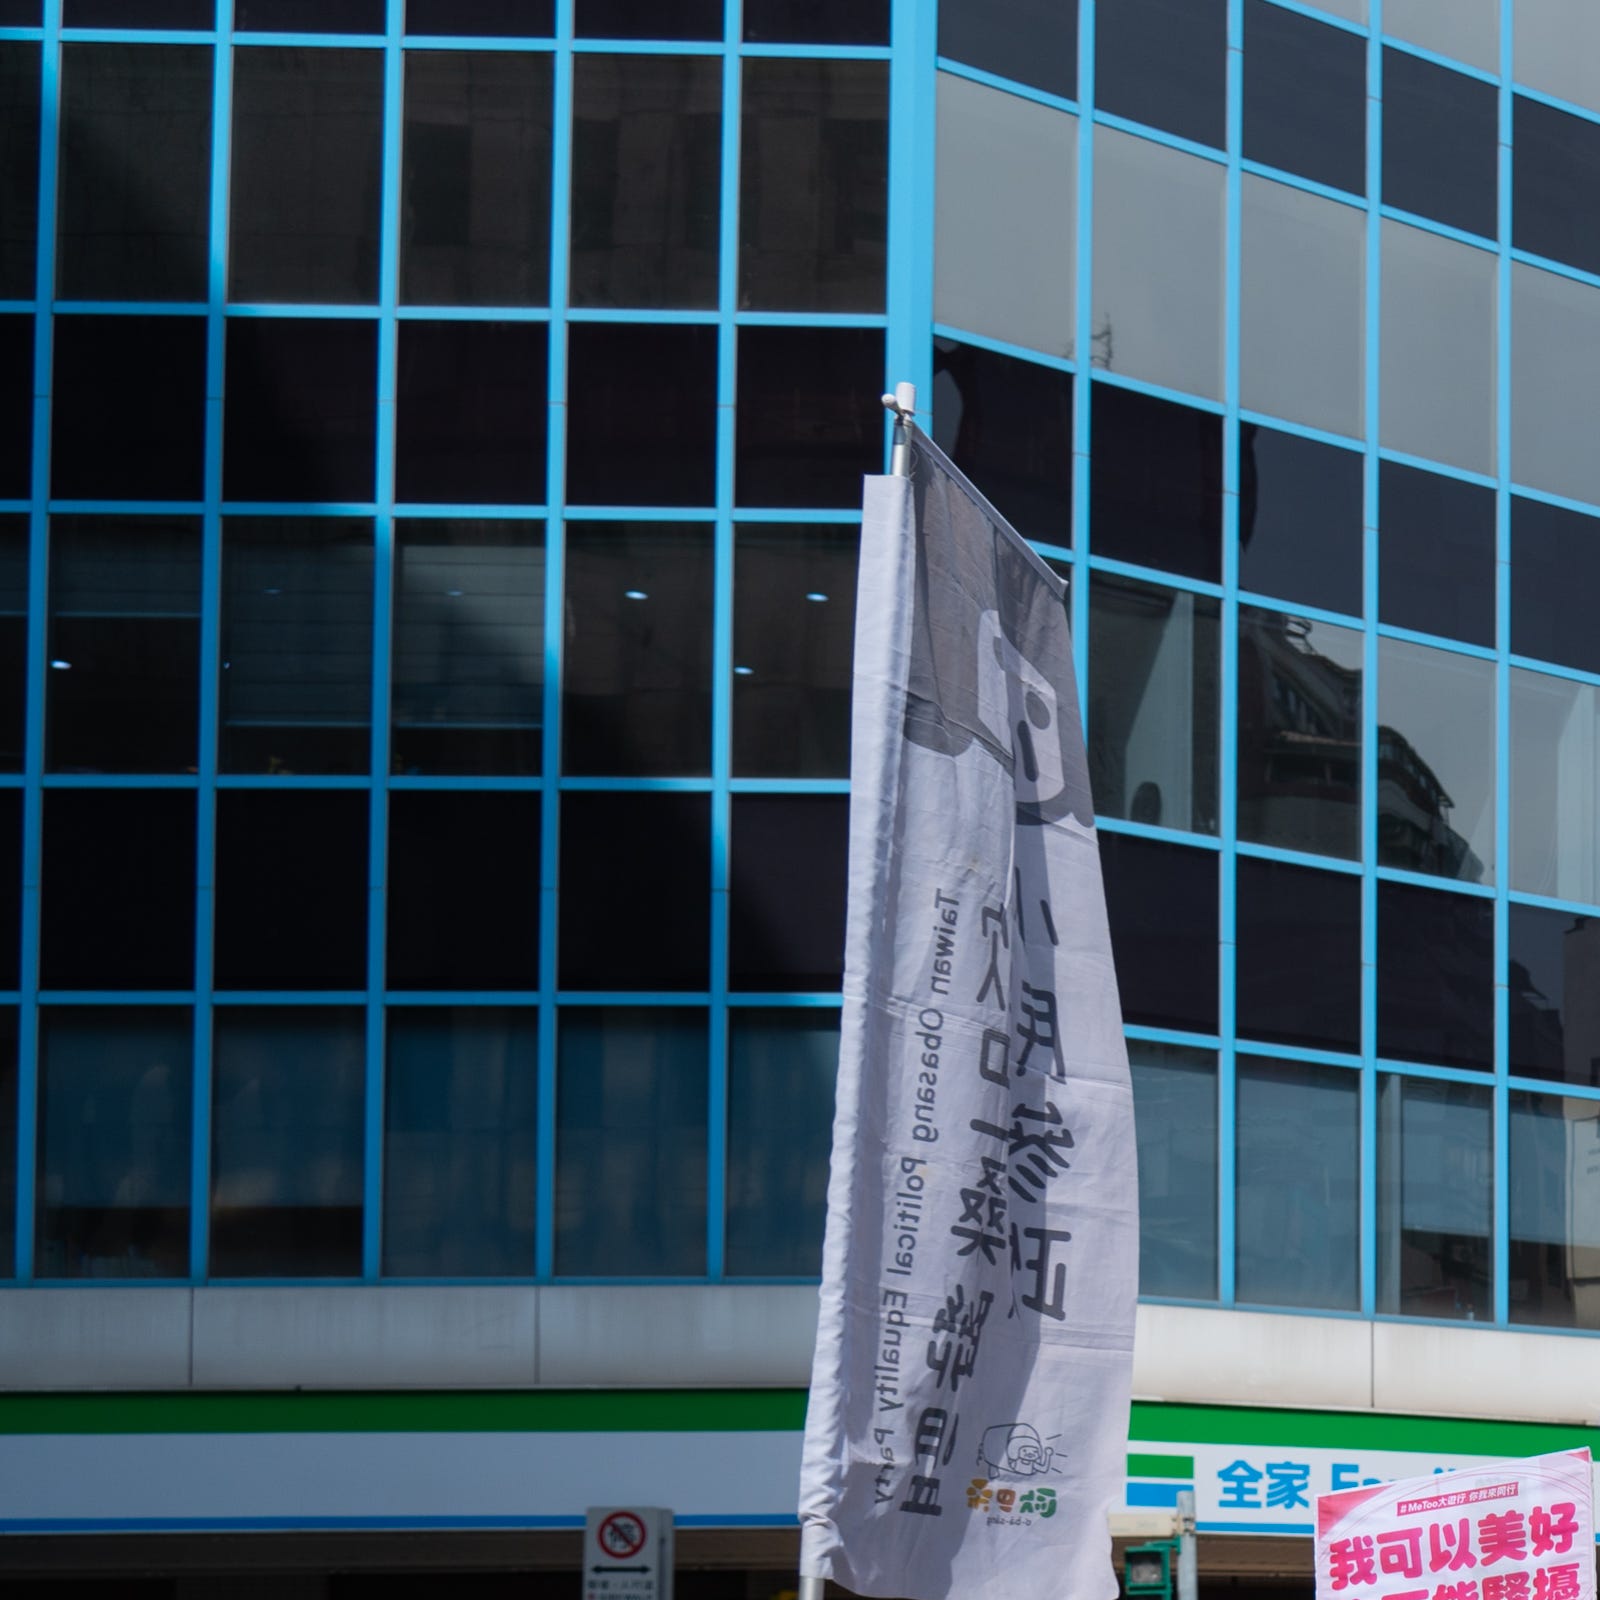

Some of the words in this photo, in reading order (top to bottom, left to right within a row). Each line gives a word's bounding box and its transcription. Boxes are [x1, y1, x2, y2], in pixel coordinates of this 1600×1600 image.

[1217, 1460, 1310, 1510] 全家
[1329, 1502, 1579, 1591] 我可以美好
